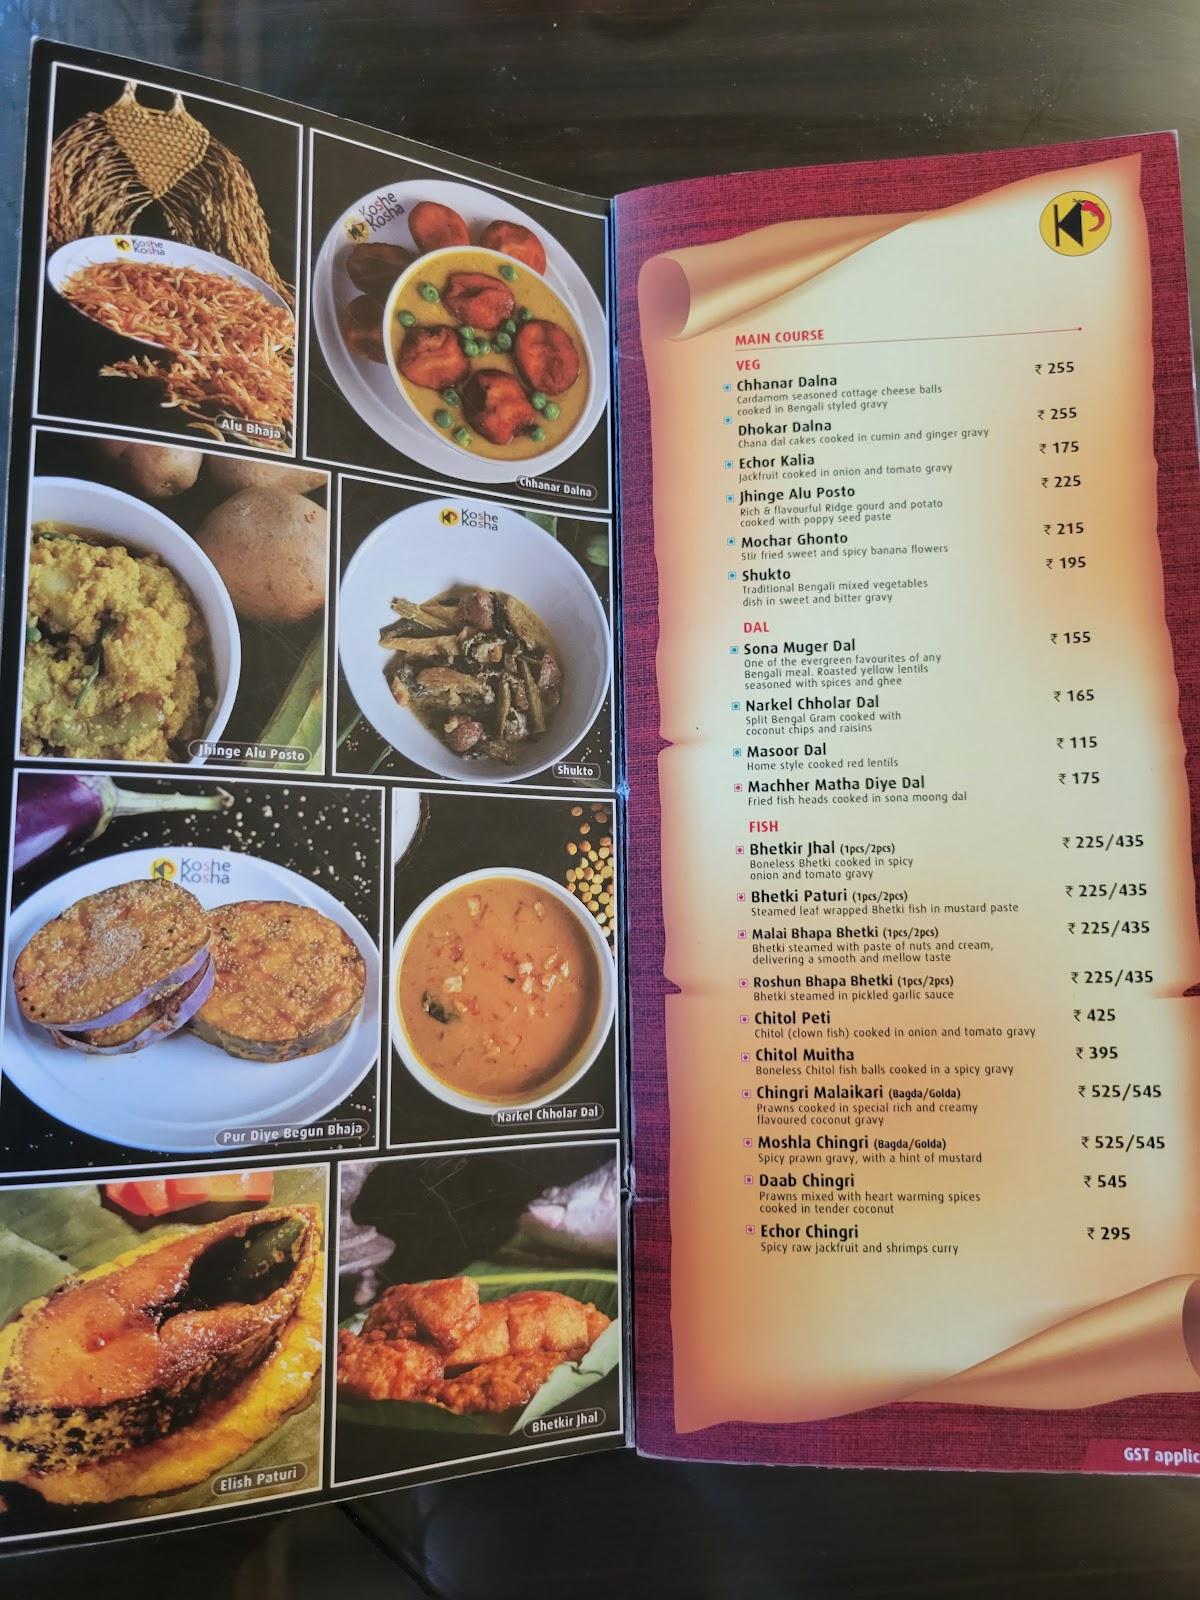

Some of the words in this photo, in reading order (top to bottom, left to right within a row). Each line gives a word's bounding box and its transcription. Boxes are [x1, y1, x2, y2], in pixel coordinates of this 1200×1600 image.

[359, 193, 398, 219] Koshe
[365, 203, 406, 232] Kosha
[735, 332, 770, 346] MAIN
[775, 329, 824, 342] COURSE
[735, 359, 760, 371] VEG
[1047, 361, 1074, 374] 255
[736, 378, 793, 391] Chhanar
[798, 374, 837, 387] Dalna
[221, 419, 242, 432] Alu
[246, 424, 280, 439] Bhaja
[738, 422, 787, 436] Dhokar
[792, 419, 831, 432] Dalna
[737, 438, 767, 448] Chana
[770, 436, 785, 446] dal
[788, 435, 816, 445] cakes
[819, 432, 854, 443] cooked
[857, 433, 866, 441] in
[870, 431, 900, 441] cumin
[903, 429, 922, 439] and
[925, 430, 957, 441] ginger
[961, 429, 988, 439] gravy
[1052, 440, 1079, 453] 175
[739, 455, 775, 469] Echor
[780, 453, 814, 466] Kalia
[738, 470, 778, 484] Jackfruit
[782, 468, 816, 479] cooked
[820, 468, 829, 477] in
[832, 467, 860, 476] onion
[863, 465, 882, 475] and
[886, 464, 921, 474] tomato
[925, 464, 952, 474] gravy
[520, 477, 560, 492] Chhanar
[564, 484, 592, 497] Dalna
[738, 489, 784, 505] Jhinge
[788, 486, 811, 499] Alu
[816, 486, 855, 498] Posto
[462, 508, 498, 523] Koshe
[462, 518, 498, 531] Kosha
[741, 534, 791, 548] Mochar
[797, 532, 847, 545] Ghonto
[741, 551, 756, 560] Stir
[761, 549, 783, 560] fried
[787, 548, 816, 558] sweet
[820, 547, 838, 557] and
[842, 547, 867, 558] spicy
[870, 545, 907, 555] banana
[911, 544, 948, 553] flowers
[1059, 556, 1086, 568] 195
[742, 567, 790, 581] Shukto
[743, 621, 769, 633] DAL
[744, 643, 777, 655] Sona
[783, 641, 828, 656] Muger
[833, 638, 855, 651] Dal
[744, 678, 791, 690] seasoned
[795, 677, 817, 688] with
[821, 677, 851, 689] spices
[855, 676, 873, 686] and
[876, 675, 902, 687] ghee
[1066, 688, 1094, 701] 165
[746, 697, 792, 712] Narkel
[797, 695, 851, 710] Chholar
[856, 694, 878, 708] Dal
[199, 744, 240, 758] Jhinge
[245, 746, 266, 758] Alu
[270, 749, 304, 760] Posto
[747, 745, 798, 758] Masoor
[804, 742, 826, 755] Dal
[558, 764, 594, 776] Shukto
[747, 761, 776, 771] Home
[780, 759, 803, 771] style
[807, 758, 843, 768] cooked
[847, 758, 863, 768] red
[867, 757, 898, 767] lentils
[748, 778, 809, 792] Machher
[815, 776, 859, 790] Matha
[865, 776, 896, 792] Diye
[902, 775, 924, 788] Dal
[749, 820, 778, 832] FISH
[750, 841, 802, 855] Bhetkir
[807, 840, 834, 857] Jhal
[840, 842, 895, 855] (1pcs/2pcs)
[1075, 834, 1144, 851] 225/435
[181, 858, 231, 872] Koshe
[181, 868, 230, 884] Kosha
[751, 888, 798, 902] Bhetki
[804, 889, 846, 902] Paturi
[852, 890, 907, 903] (1pcs/2pcs)
[752, 926, 786, 939] Malai
[791, 926, 831, 941] Bhapa
[836, 925, 878, 938] Bhetki
[882, 926, 938, 940] (1pcs/2pcs)
[753, 975, 800, 987] Roshun
[805, 974, 846, 989] Bhapa
[850, 973, 892, 986] Bhetki
[897, 975, 953, 988] (1pcs/2pcs)
[753, 990, 786, 1001] Bhetki
[789, 989, 834, 1000] steamed
[838, 990, 847, 1000] in
[851, 989, 888, 1002] pickled
[892, 989, 920, 1002] garlic
[754, 1010, 796, 1024] Chitol
[802, 1010, 830, 1024] Peti
[1086, 1008, 1115, 1021] 425
[755, 1047, 797, 1061] Chitol
[803, 1046, 854, 1061] Muitha
[756, 1084, 808, 1102] Chingri
[813, 1084, 883, 1098] Malaikari
[888, 1087, 960, 1100] (Bagda/Golda)
[1092, 1083, 1161, 1100] 525/545
[497, 1109, 532, 1122] Narkel
[536, 1106, 577, 1120] Chholar
[581, 1105, 598, 1117] Dal
[757, 1114, 806, 1124] flavoured
[810, 1115, 850, 1125] coconut
[854, 1116, 883, 1127] gravy
[223, 1131, 246, 1143] Pur
[250, 1128, 279, 1142] Diye
[283, 1127, 323, 1140] Begun
[328, 1122, 362, 1135] Bhaja
[758, 1134, 810, 1148] Moshla
[816, 1134, 868, 1152] Chingri
[873, 1138, 946, 1151] (Bagda/Golda)
[759, 1172, 796, 1186] Daab
[802, 1172, 854, 1190] Chingri
[760, 1223, 800, 1238] Echor
[805, 1223, 858, 1241] Chingri
[1100, 1226, 1130, 1240] 295
[760, 1241, 787, 1254] Spicy
[792, 1244, 811, 1252] raw
[815, 1242, 858, 1254] jackfruit
[862, 1242, 882, 1252] and
[886, 1242, 928, 1255] shrimps
[931, 1244, 958, 1255] curry
[532, 1416, 574, 1432] Bhetkir
[576, 1410, 598, 1428] Jhal
[1124, 1447, 1150, 1461] GST
[220, 1474, 252, 1492] Elish
[257, 1466, 296, 1485] Paturi
